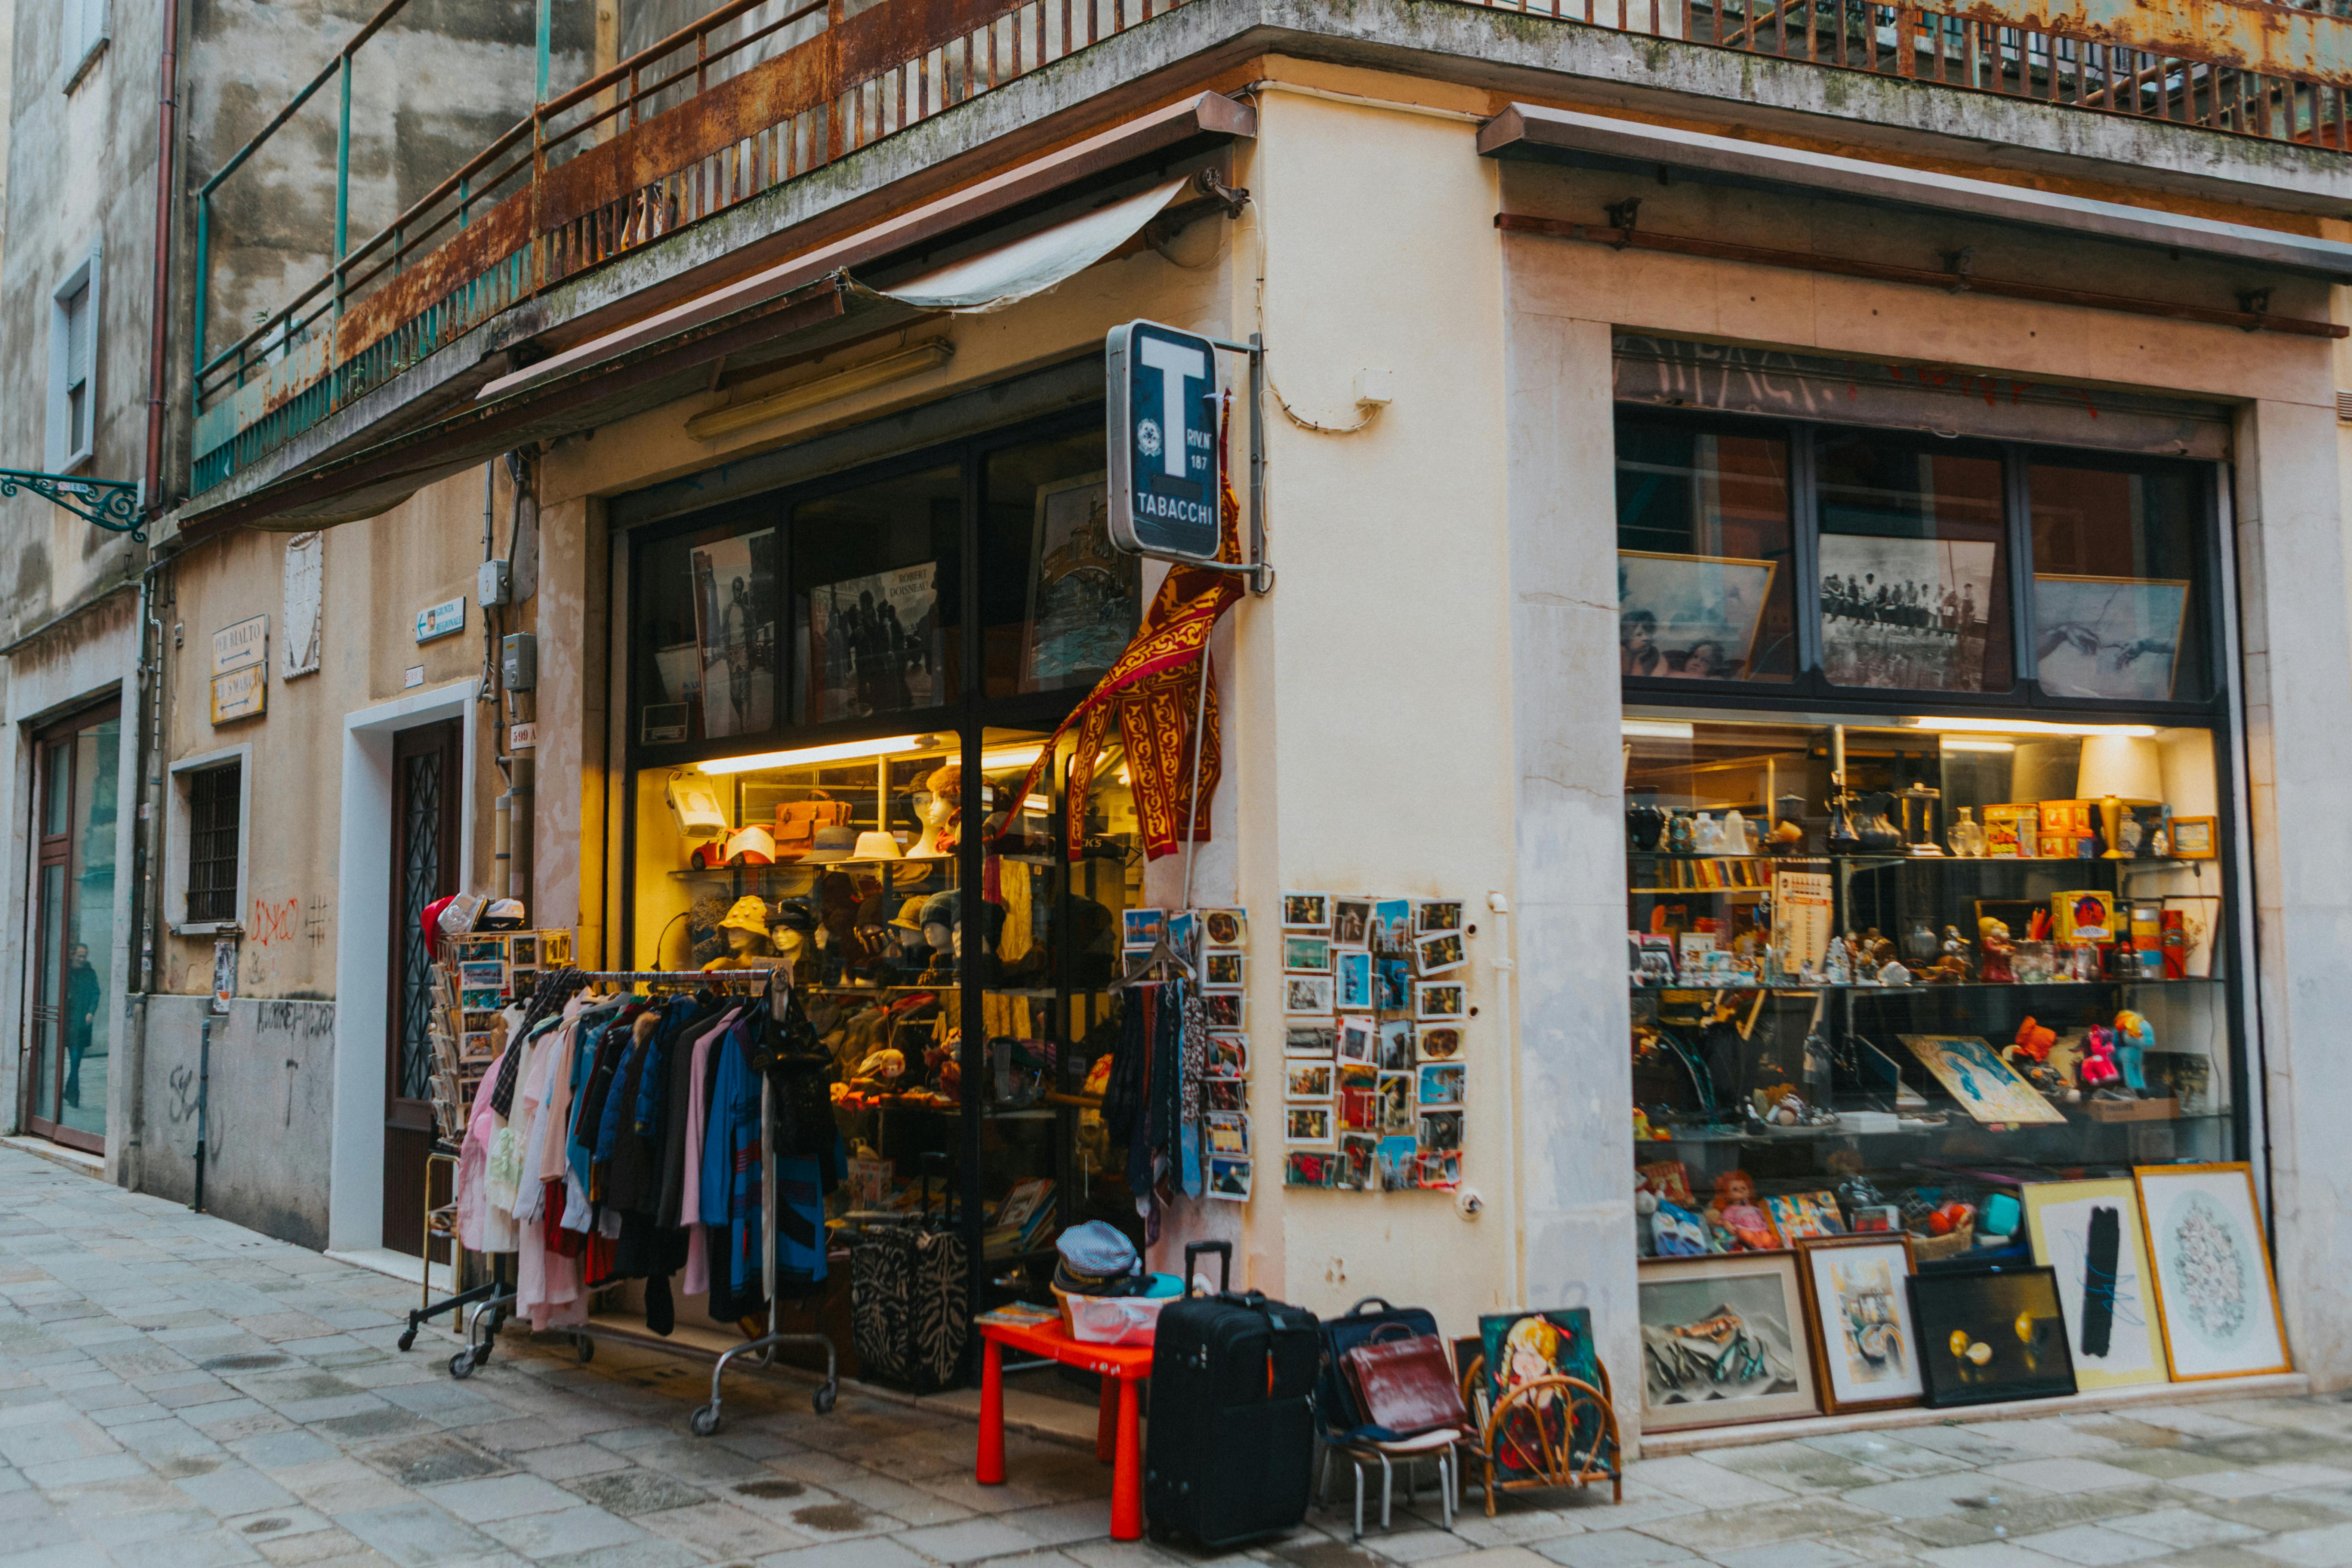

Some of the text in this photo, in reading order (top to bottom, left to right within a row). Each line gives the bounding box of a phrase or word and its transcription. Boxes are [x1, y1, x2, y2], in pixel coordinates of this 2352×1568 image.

[1141, 336, 1205, 478] T
[1191, 455, 1207, 470] 187
[1137, 492, 1212, 526] TABACCHI
[898, 569, 928, 583] ROBERT
[890, 580, 928, 597] DOISNEAU
[436, 604, 454, 617] GIUNTA
[436, 615, 462, 631] REGIONALE
[215, 623, 261, 653] PER RIALTO
[513, 727, 536, 743] 599 A
